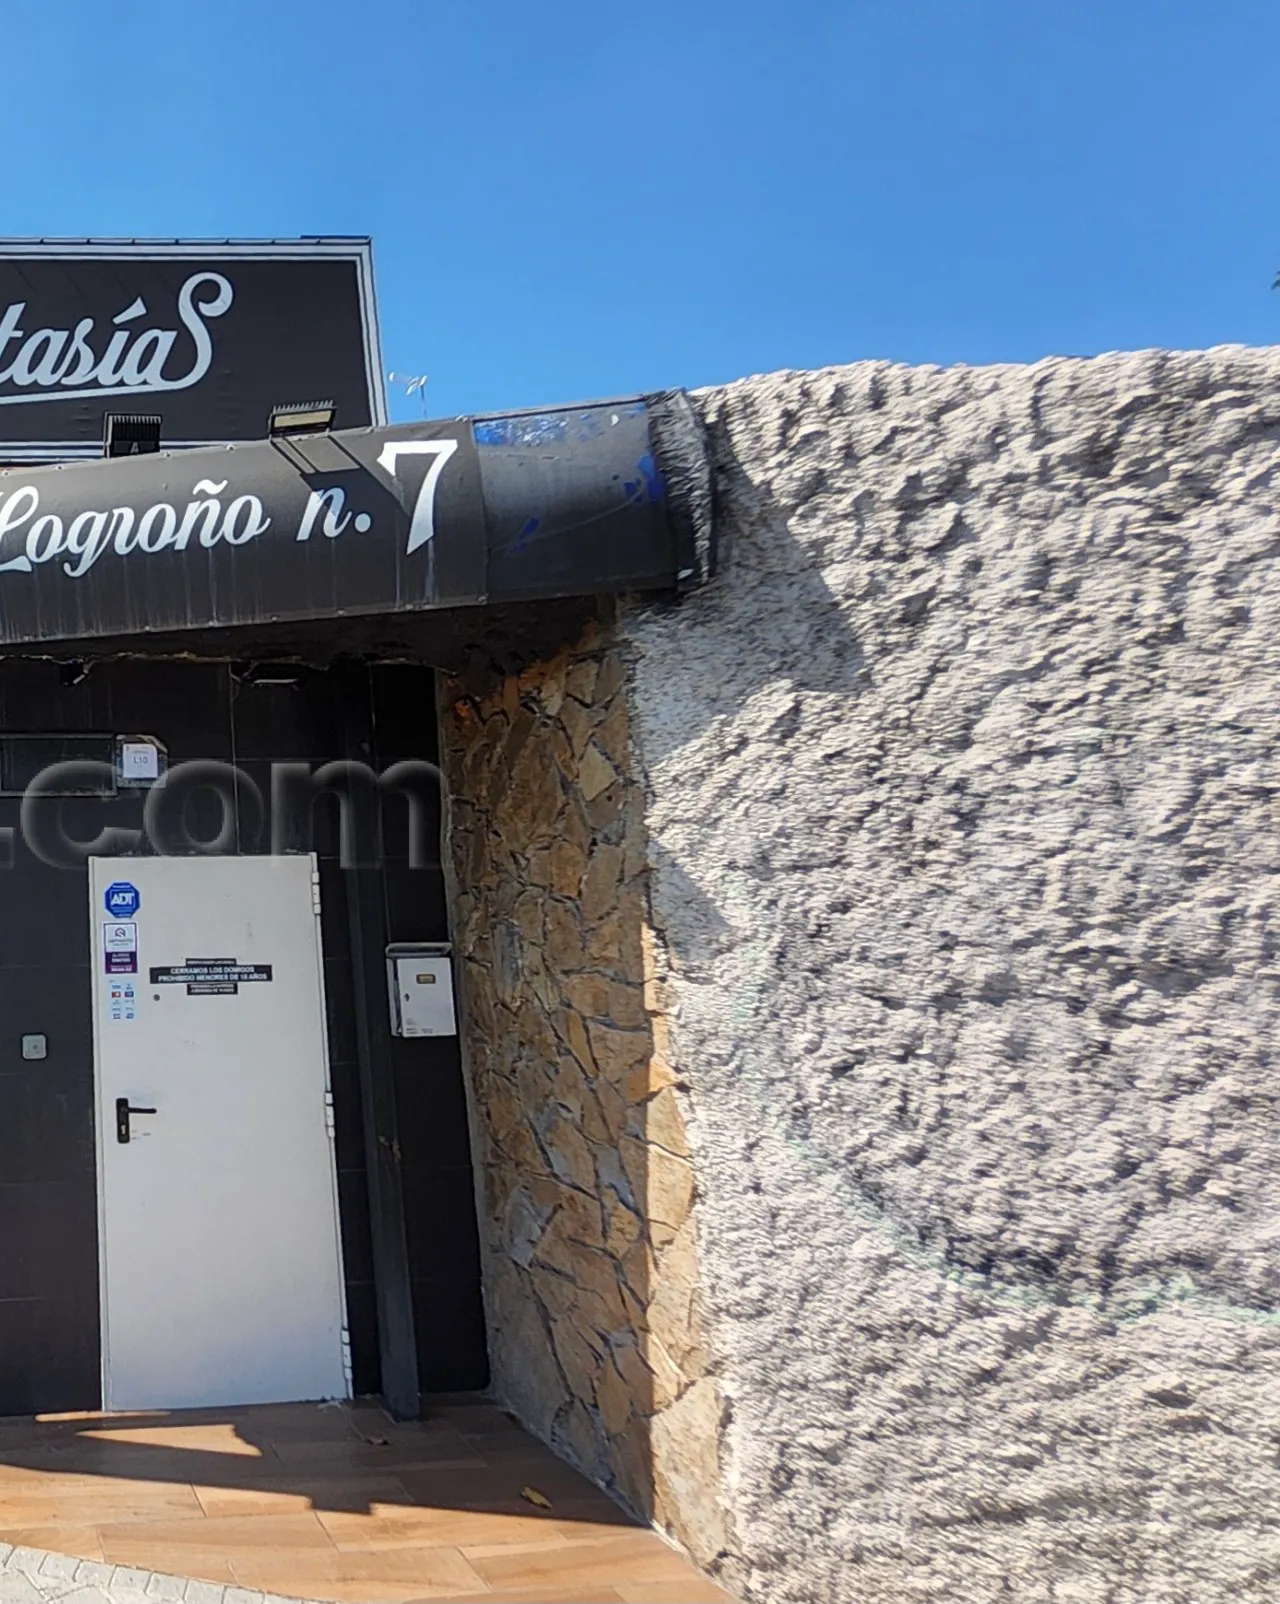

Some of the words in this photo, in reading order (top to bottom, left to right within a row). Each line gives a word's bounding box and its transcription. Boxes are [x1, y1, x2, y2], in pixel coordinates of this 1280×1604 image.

[297, 487, 373, 542] n.
[377, 439, 459, 556] 7
[111, 892, 135, 906] ADT
